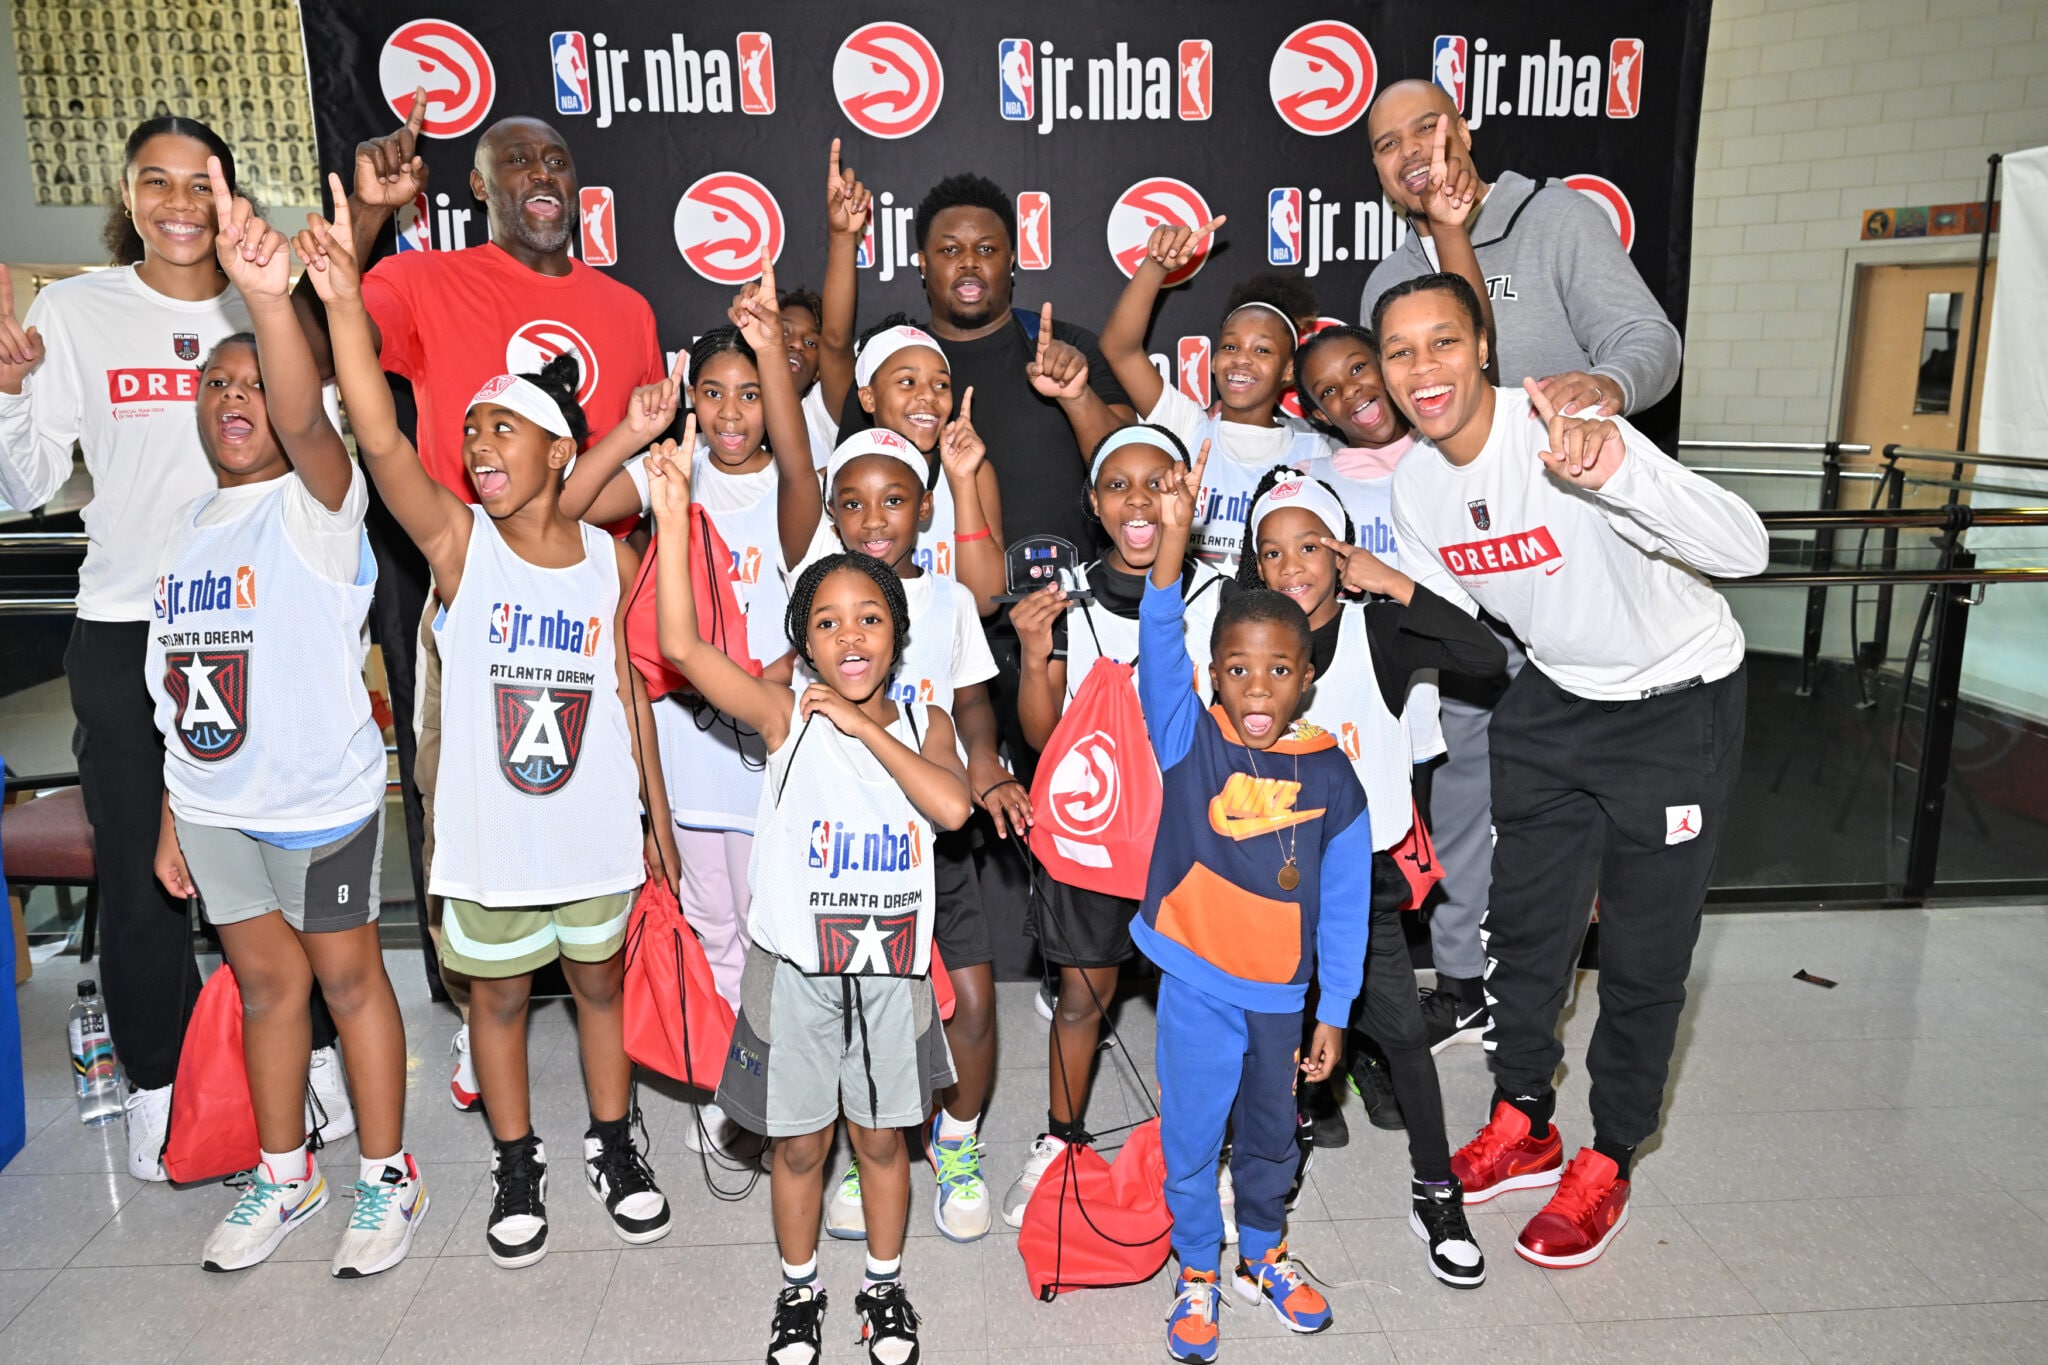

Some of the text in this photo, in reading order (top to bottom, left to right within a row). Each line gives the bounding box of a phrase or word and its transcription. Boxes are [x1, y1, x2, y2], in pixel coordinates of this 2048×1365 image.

[561, 95, 578, 110] NBA
[1005, 101, 1022, 115] NBA
[879, 191, 920, 282] jr.
[1305, 188, 1407, 277] jr.nb
[1273, 247, 1288, 260] NBA
[1486, 275, 1518, 300] TL
[117, 373, 192, 398] DRE
[1204, 488, 1253, 525] jr.nb
[1189, 534, 1235, 549] ATLANTA
[1361, 516, 1398, 553] nba
[1447, 537, 1548, 572] DREAM
[158, 630, 253, 648] ATLANTA DREAM
[490, 664, 595, 686] ATLANTA DREAM
[1221, 772, 1302, 817] NIKE
[809, 889, 923, 909] ATLANTA DREAM
